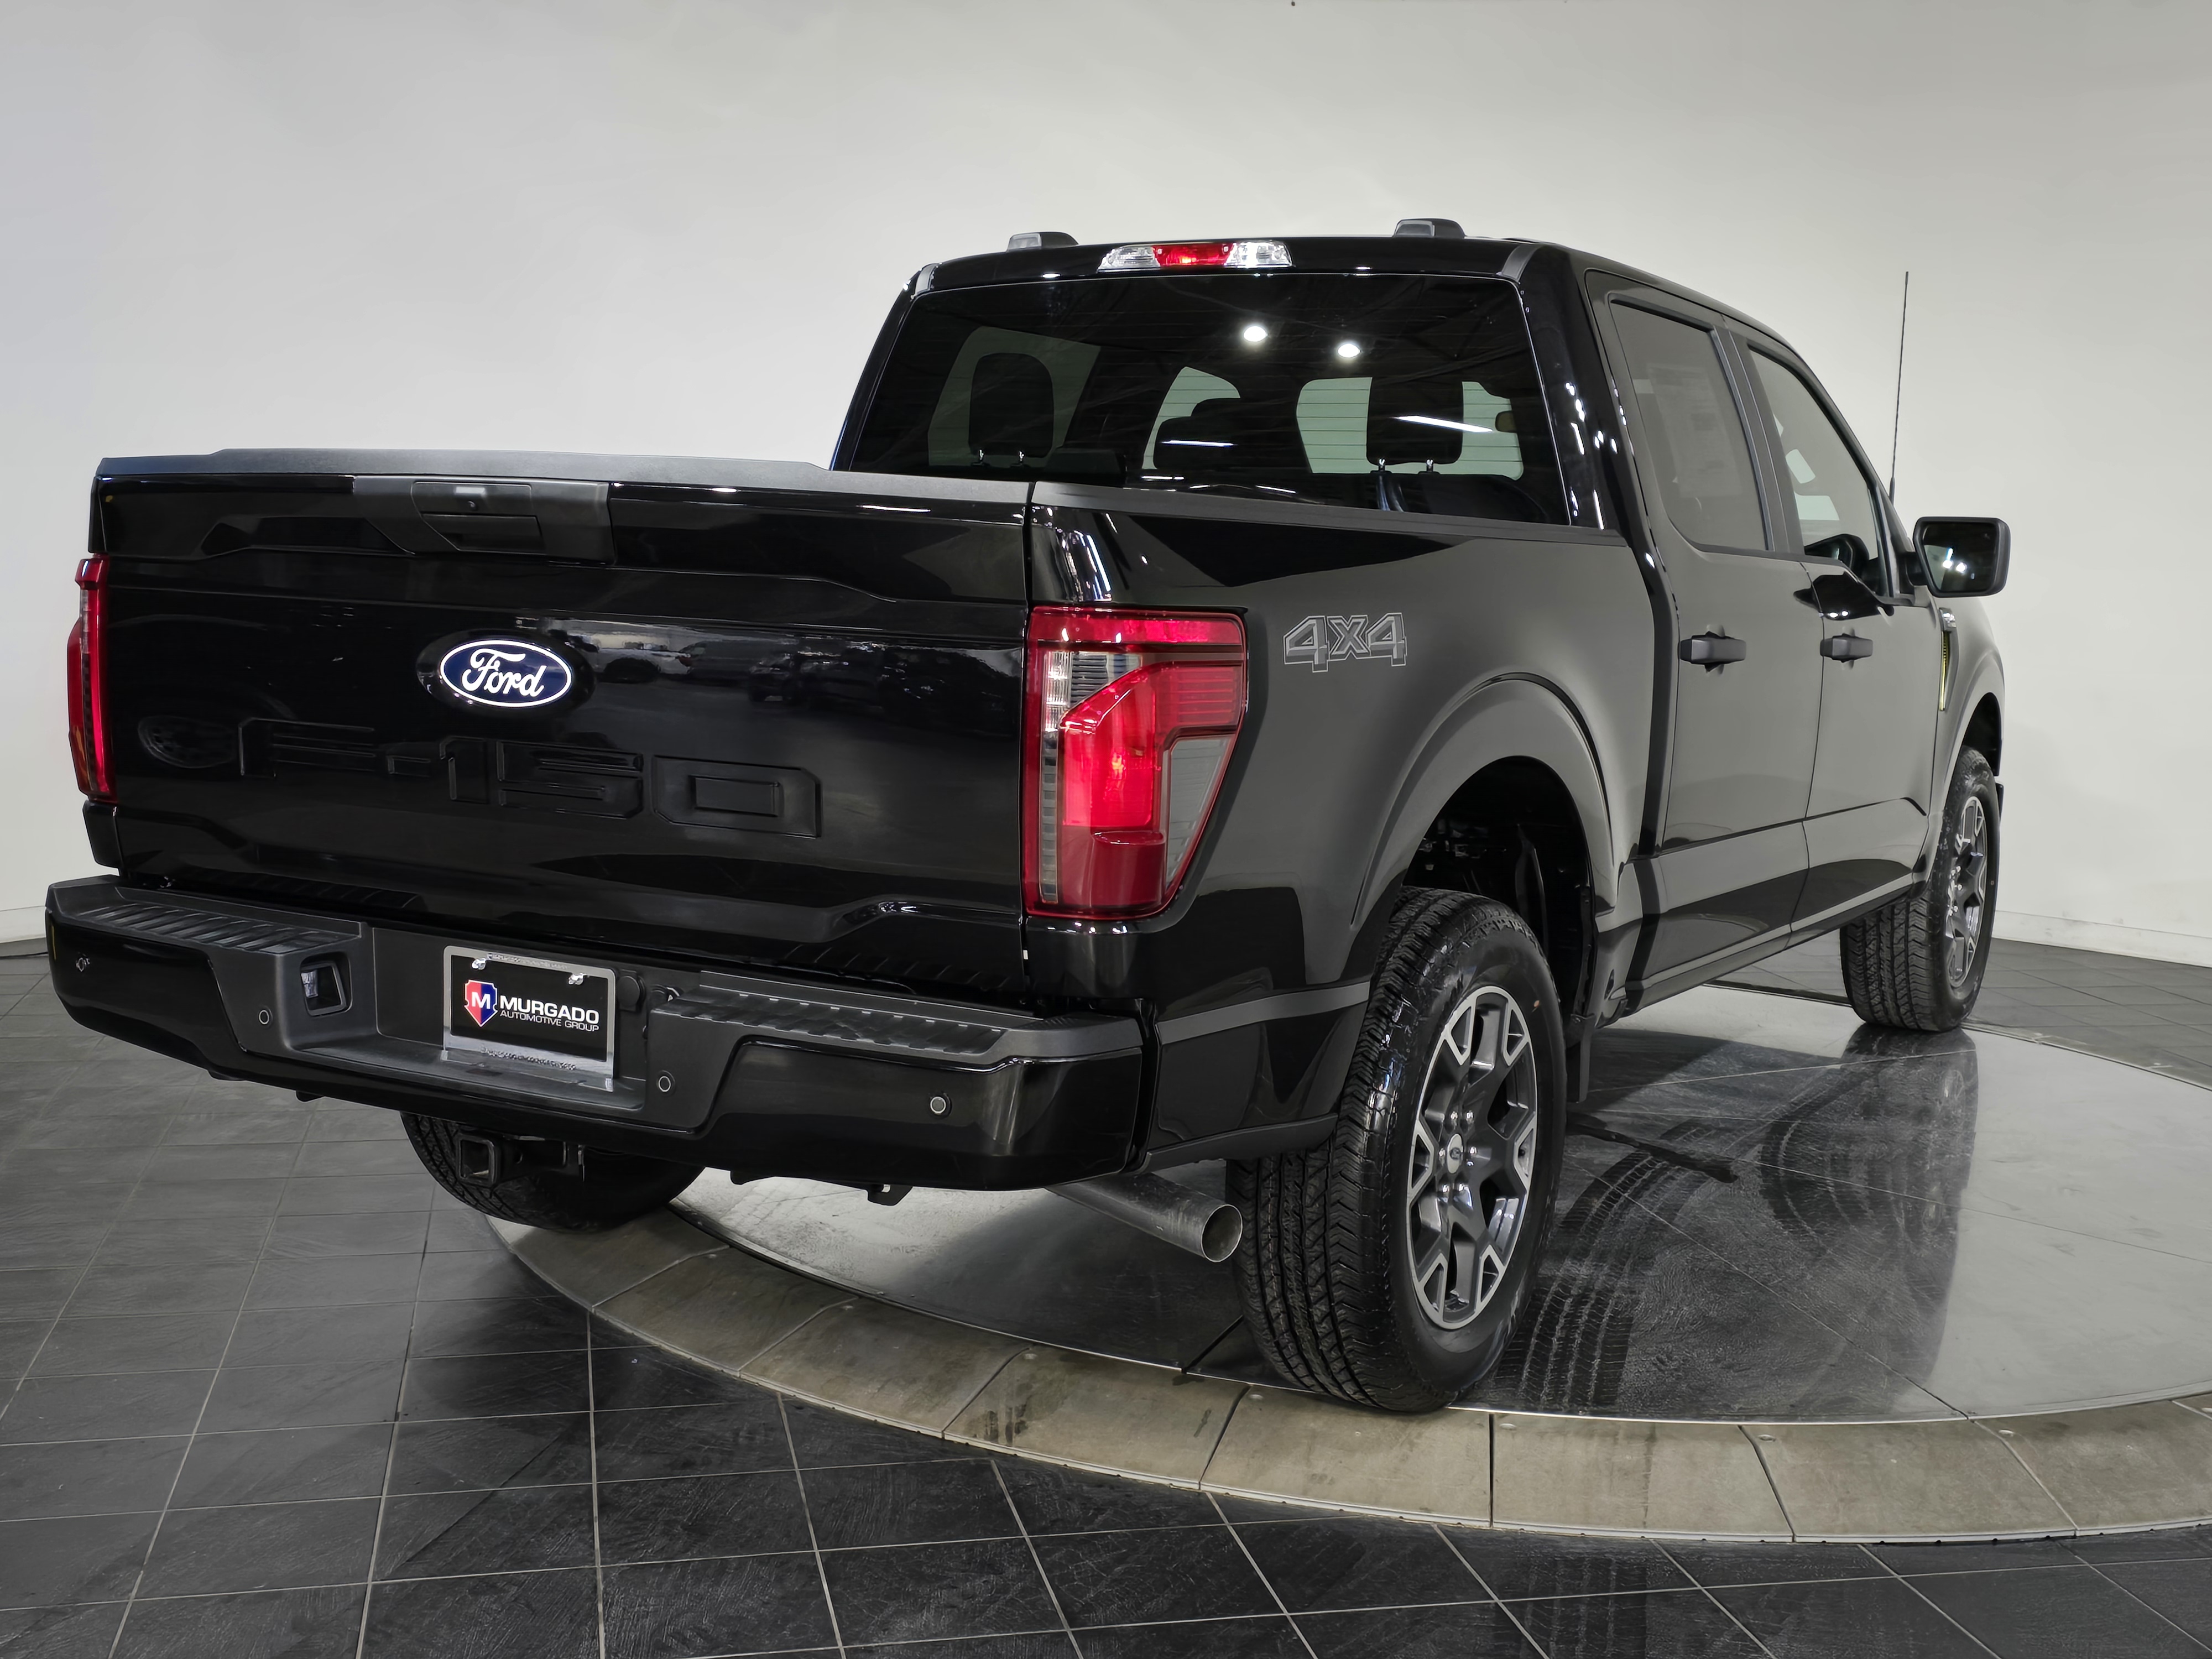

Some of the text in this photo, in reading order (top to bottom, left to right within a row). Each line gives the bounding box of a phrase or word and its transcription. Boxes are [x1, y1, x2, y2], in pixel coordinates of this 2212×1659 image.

[462, 648, 548, 697] Ford
[239, 717, 822, 839] F-150
[471, 992, 491, 1010] M
[499, 995, 600, 1024] MURGADO
[499, 1010, 599, 1032] AUTOMOTIVE GROUP
